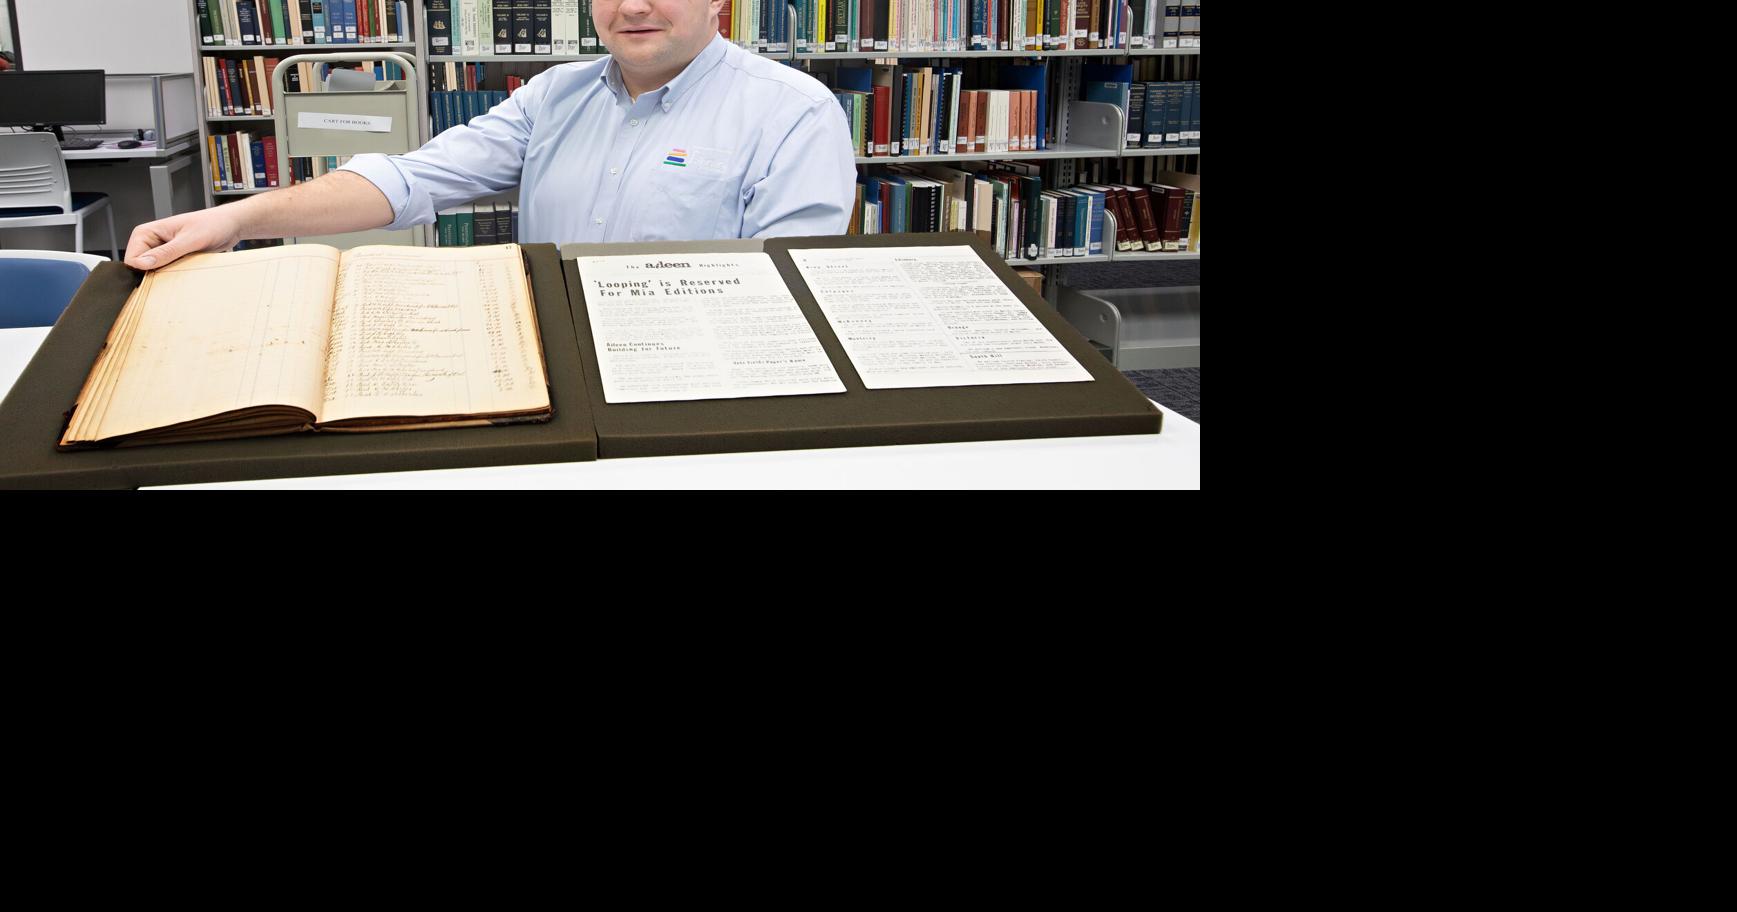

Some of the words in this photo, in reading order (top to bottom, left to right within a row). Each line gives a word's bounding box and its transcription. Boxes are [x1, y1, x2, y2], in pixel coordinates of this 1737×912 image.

[680, 278, 740, 287] Reserved
[600, 289, 621, 297] For
[665, 287, 724, 296] Editions
